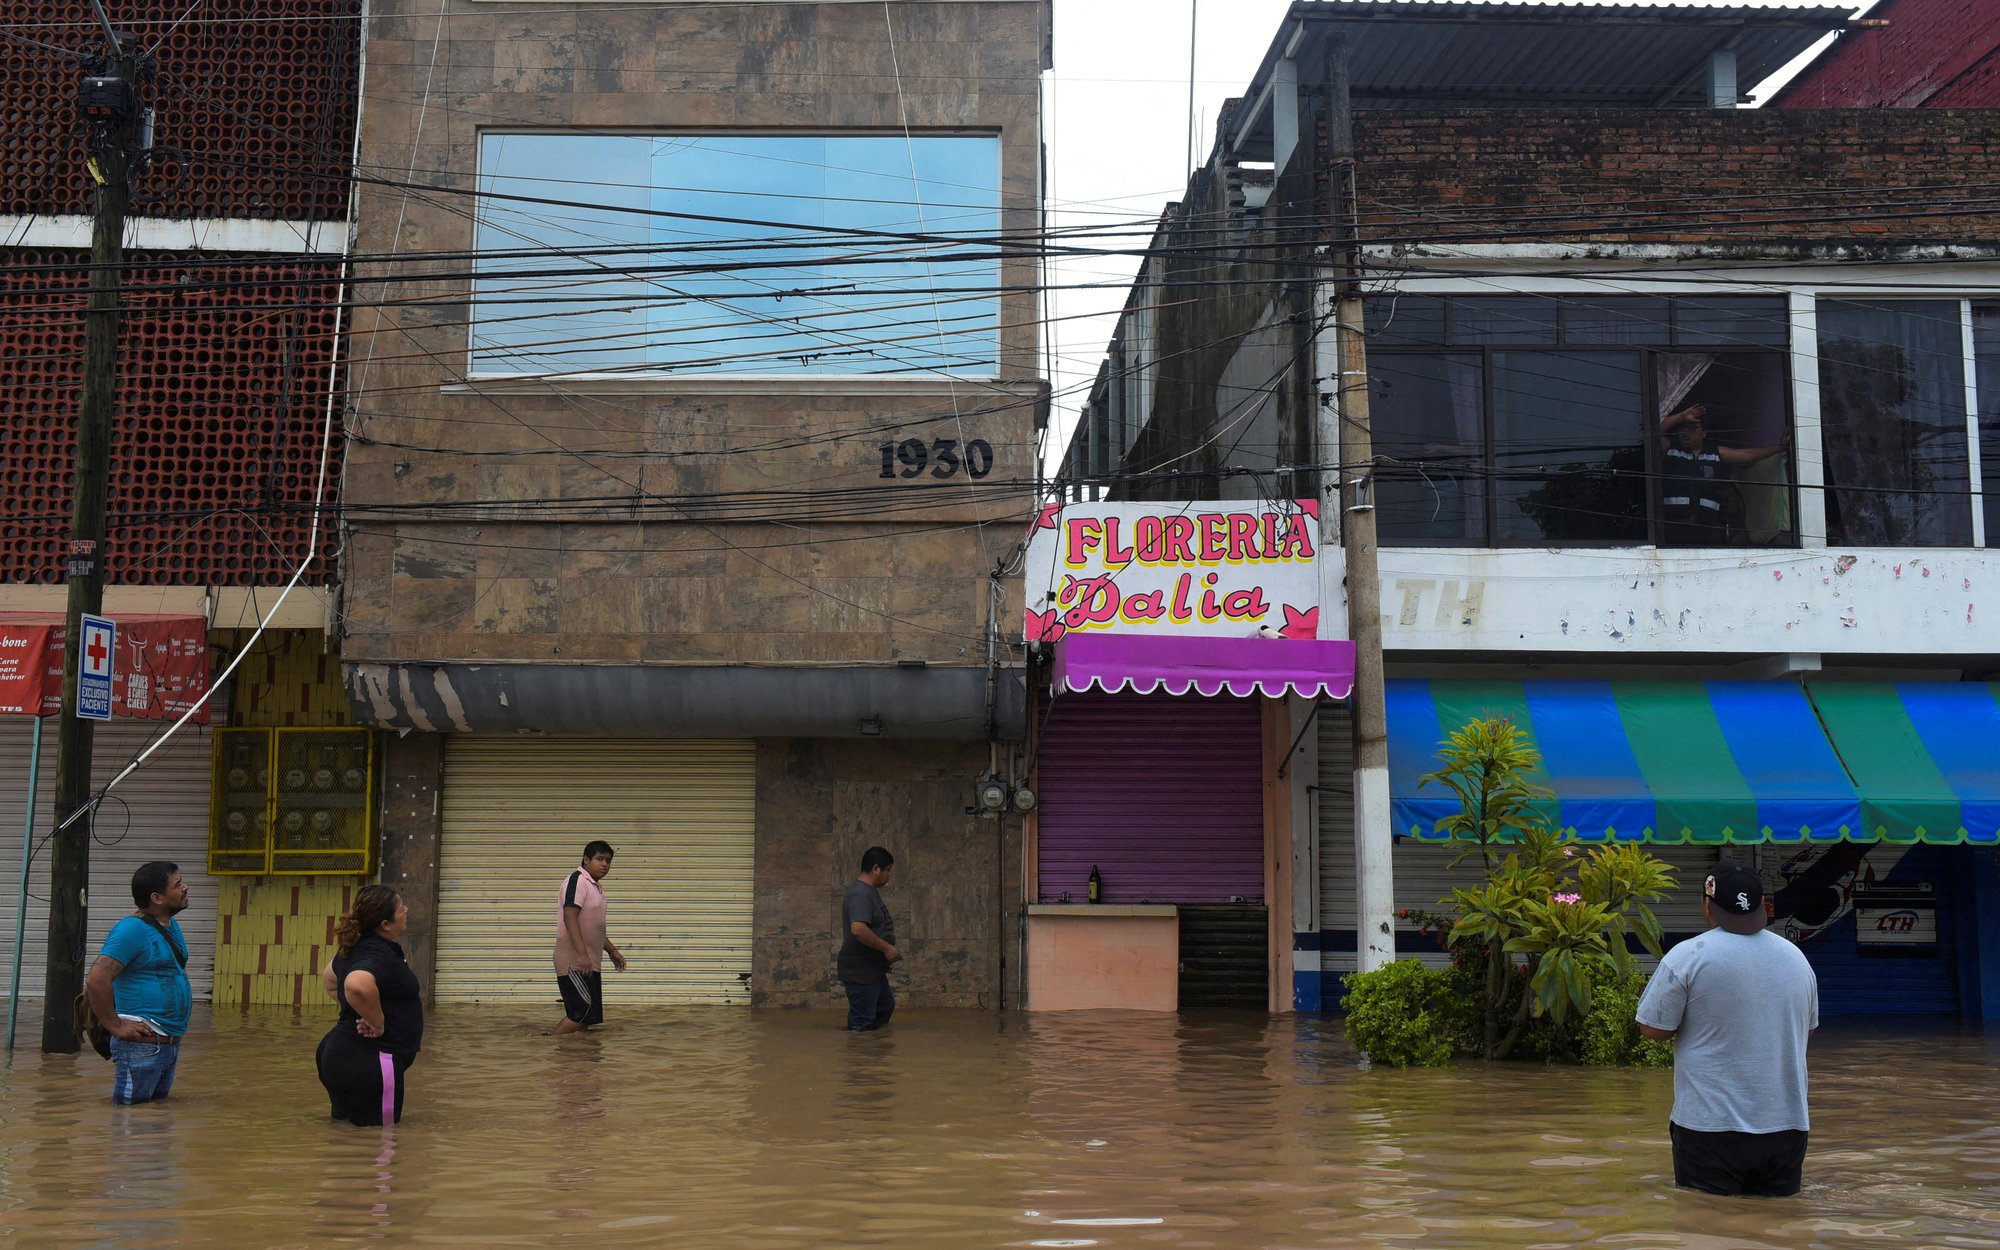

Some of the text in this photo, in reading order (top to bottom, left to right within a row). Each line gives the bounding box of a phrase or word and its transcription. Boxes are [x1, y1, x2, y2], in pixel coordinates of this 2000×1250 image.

[879, 437, 993, 479] 1930
[1064, 513, 1315, 566] FLORERIA
[1058, 572, 1270, 630] Dalia
[1380, 579, 1486, 625] TH
[81, 698, 108, 711] PACIENTE
[82, 687, 109, 700] EXCLUSIVO
[1877, 917, 1915, 931] LTH
